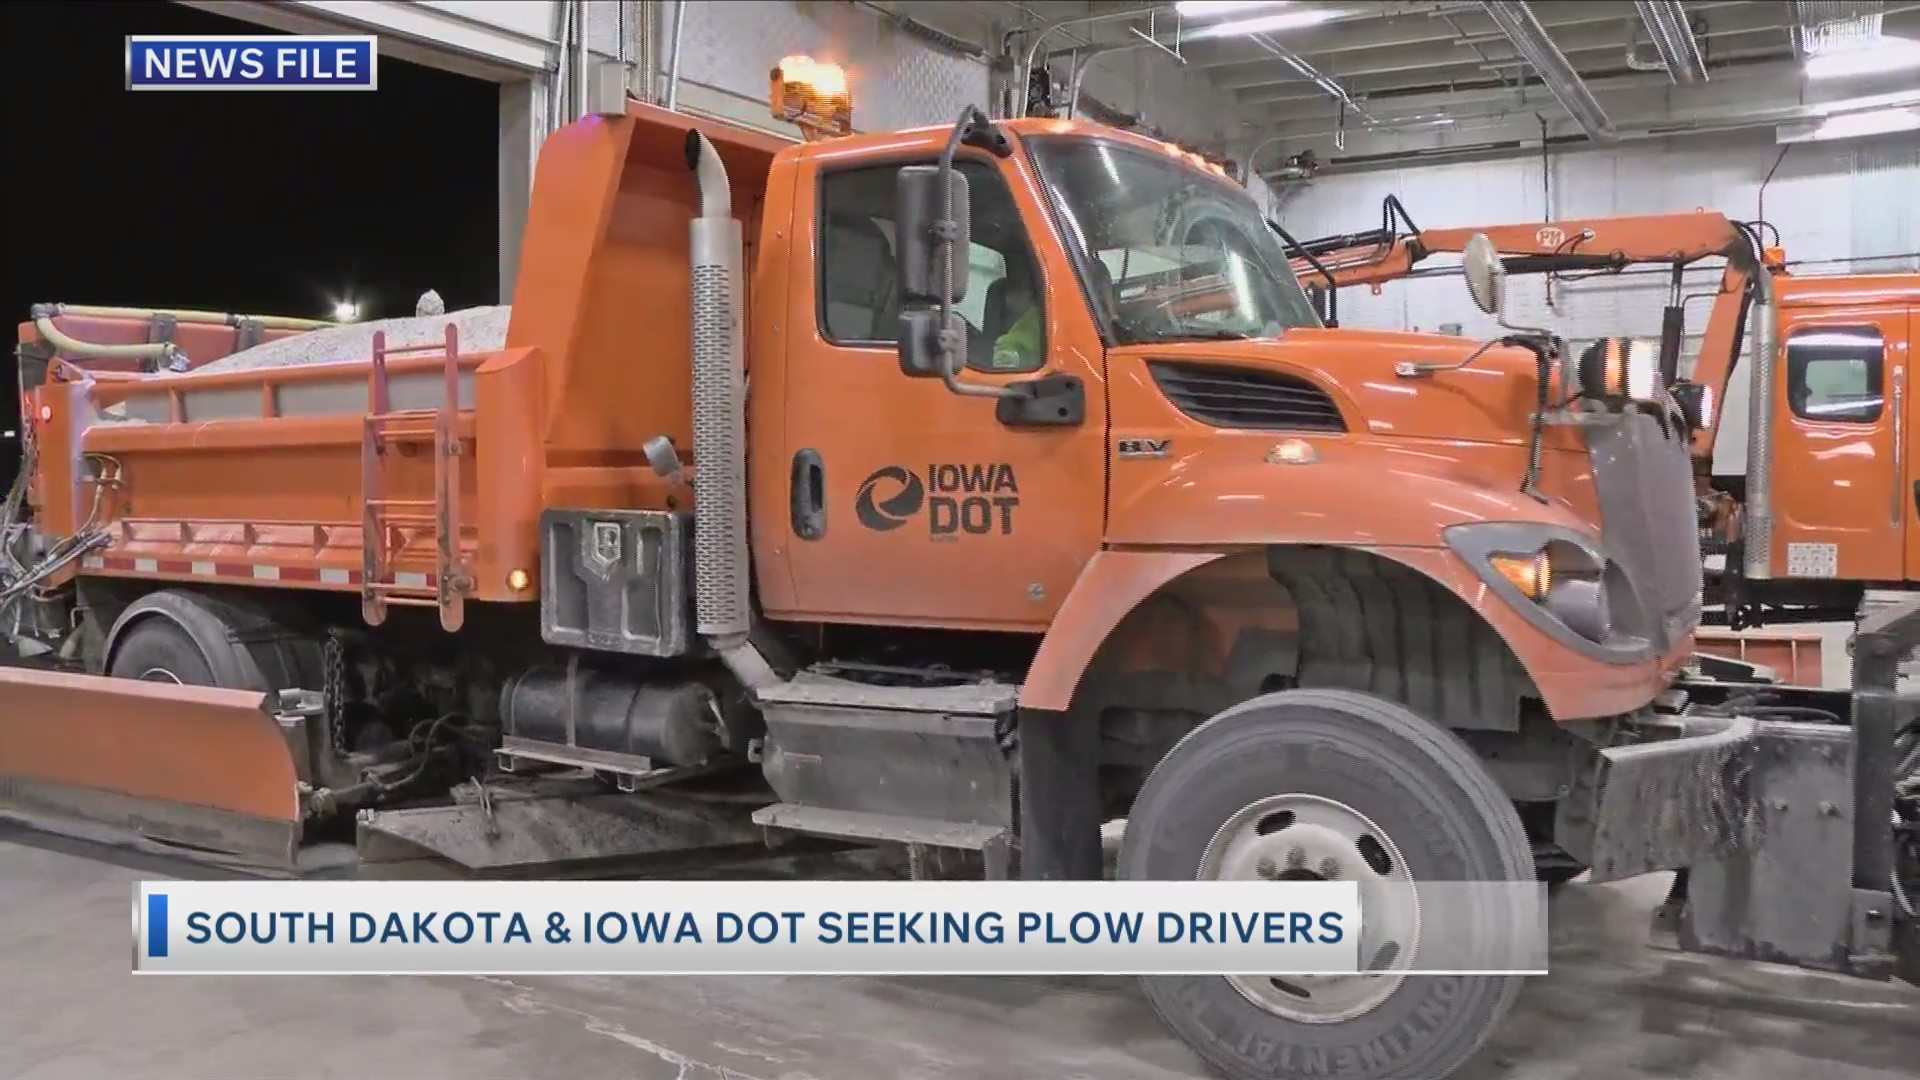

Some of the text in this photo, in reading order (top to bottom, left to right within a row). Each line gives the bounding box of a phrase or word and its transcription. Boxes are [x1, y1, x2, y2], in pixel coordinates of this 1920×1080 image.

[928, 463, 1018, 493] IOWA
[929, 496, 1020, 535] DOT
[1236, 975, 1460, 1077] ONTINENTAL
